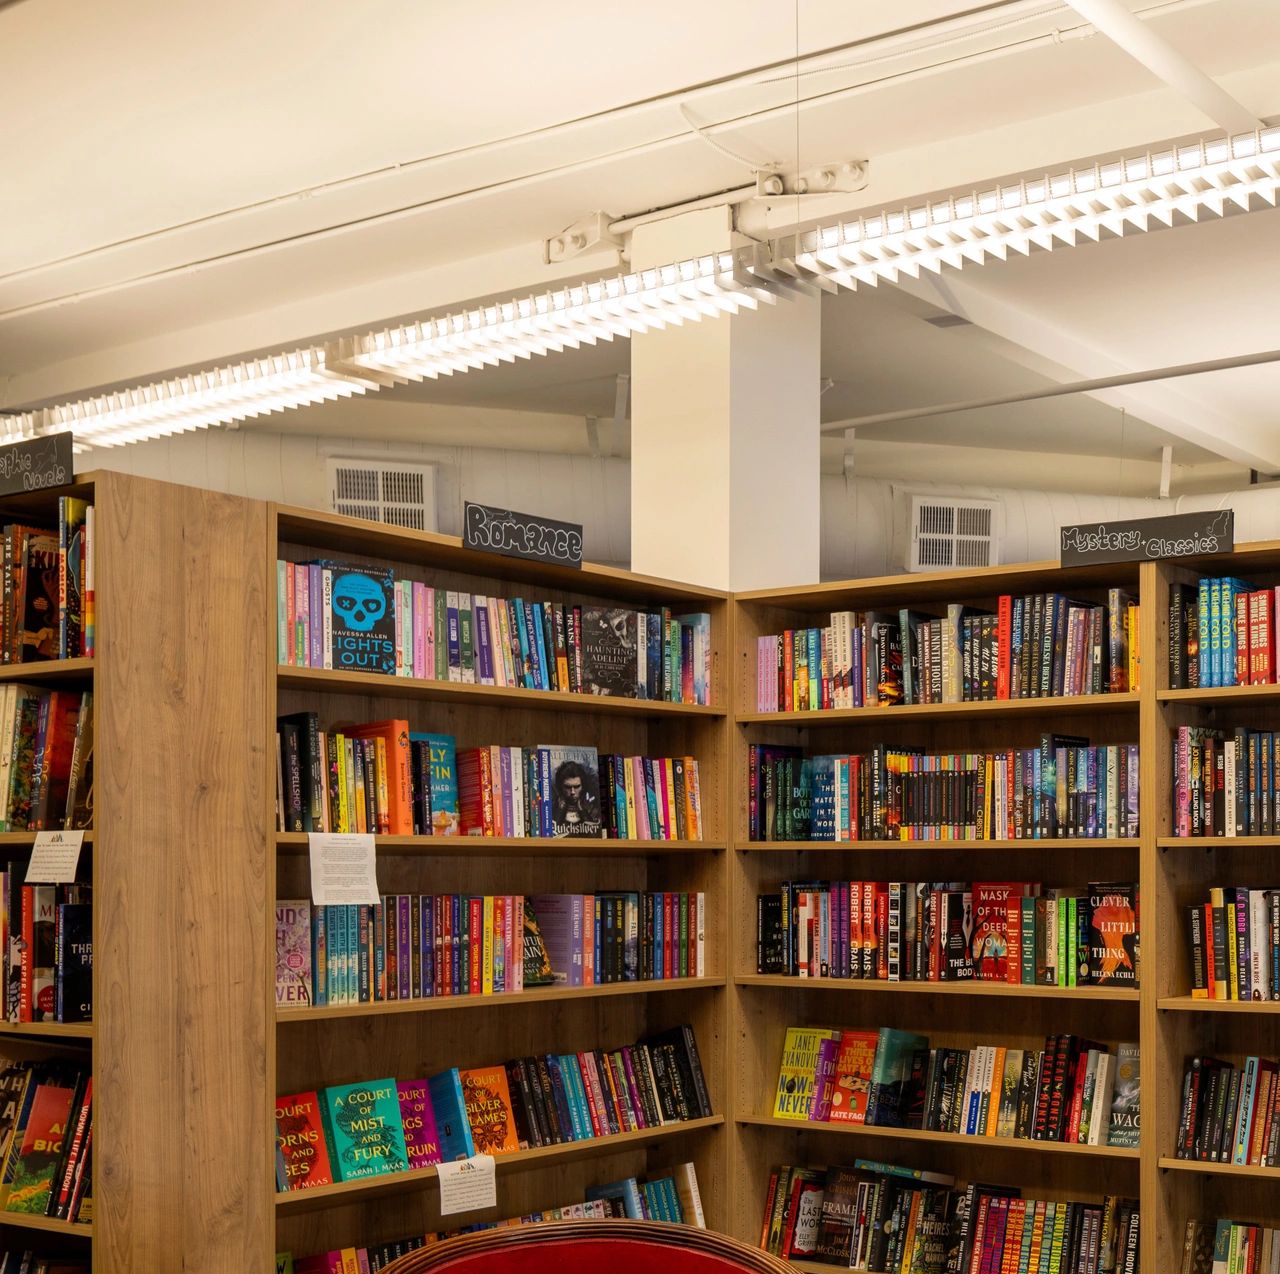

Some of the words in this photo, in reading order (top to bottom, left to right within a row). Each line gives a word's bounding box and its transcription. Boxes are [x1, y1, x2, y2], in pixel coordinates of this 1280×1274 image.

[23, 466, 65, 490] Novels
[467, 504, 582, 561] Romance
[1062, 525, 1141, 552] Mystery
[1146, 532, 1218, 558] Classics
[1046, 596, 1054, 635] MADWOMAN
[1237, 598, 1246, 624] SMOKE
[1259, 594, 1267, 623] SMOKE
[332, 637, 393, 653] IGHTS
[931, 628, 941, 653] NINTH
[1238, 627, 1246, 650] KINGS
[1259, 625, 1267, 648] KINGS
[341, 652, 379, 666] OUT
[586, 645, 634, 656] HAUNTING
[591, 654, 628, 664] ADELINE
[1043, 636, 1052, 665] CHELSEA
[931, 655, 941, 693] HOUSE
[1041, 666, 1050, 691] BIEKER
[575, 752, 596, 761] HART
[291, 766, 300, 811] SPELLSHOP
[851, 885, 859, 924] ROBERT
[864, 885, 872, 924] ROBERT
[980, 891, 1009, 900] MASK
[1091, 896, 1130, 907] CLEVER
[850, 941, 858, 970] CRAIS
[1092, 947, 1125, 959] THING
[792, 1035, 817, 1050] JANET
[466, 1074, 501, 1087] COURT
[334, 1097, 343, 1107] A
[348, 1089, 392, 1104] COURT
[475, 1089, 486, 1098] OF
[779, 1093, 810, 1113] NEVER
[360, 1105, 372, 1114] OF
[465, 1099, 501, 1113] SILVER
[78, 1105, 89, 1136] WOMAN
[351, 1116, 385, 1132] MIST
[469, 1112, 507, 1127] LAMES
[361, 1133, 381, 1144] AND
[353, 1143, 391, 1161] FURY
[408, 1143, 437, 1157] RUIN
[62, 1160, 76, 1192] FREEDOM
[346, 1167, 374, 1178] SARAH
[375, 1165, 380, 1175] J.
[382, 1161, 404, 1170] MAAS
[1128, 1214, 1139, 1249] COLLEEN
